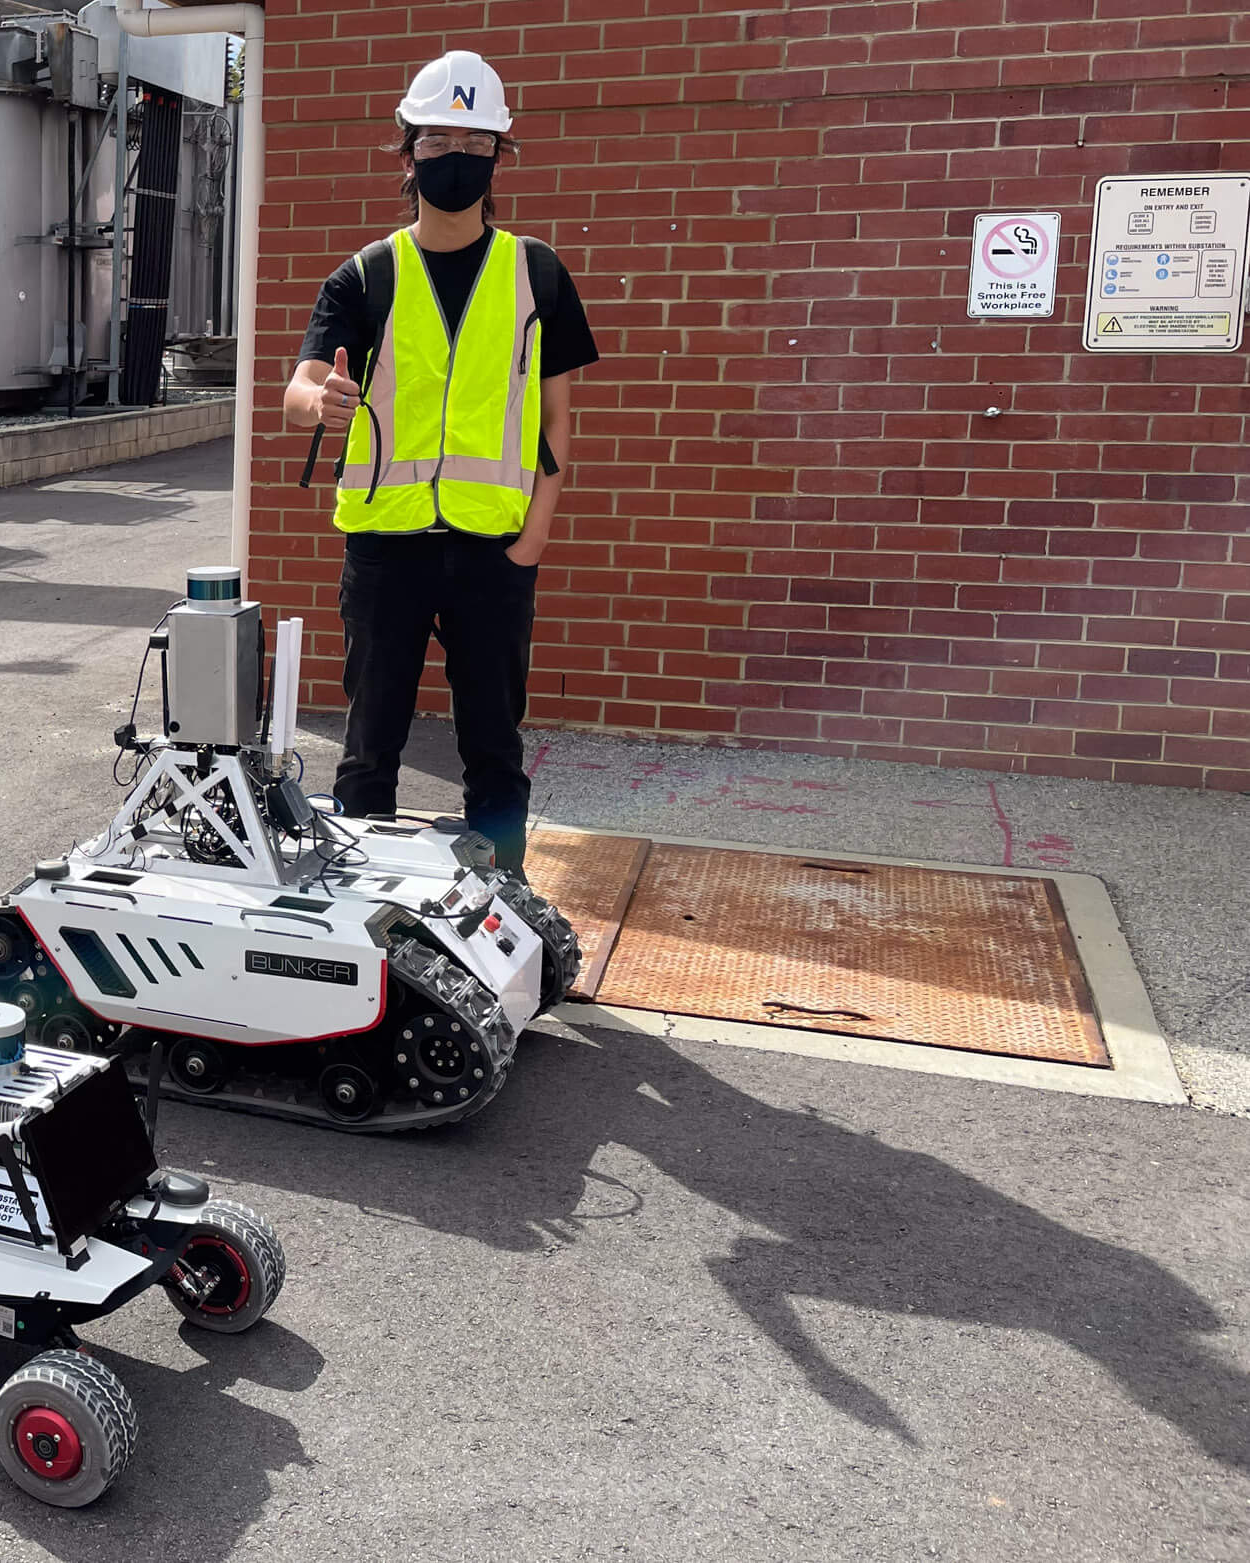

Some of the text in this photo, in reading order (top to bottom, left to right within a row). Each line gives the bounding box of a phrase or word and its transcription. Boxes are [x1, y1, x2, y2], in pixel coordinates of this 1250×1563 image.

[1141, 186, 1210, 197] REMEMBER
[1115, 243, 1163, 251] REQUIREMENTS
[989, 282, 1013, 290] This
[977, 291, 1047, 300] Smoke Free
[980, 301, 1042, 310] Workplace
[251, 953, 351, 981] BUNKER
